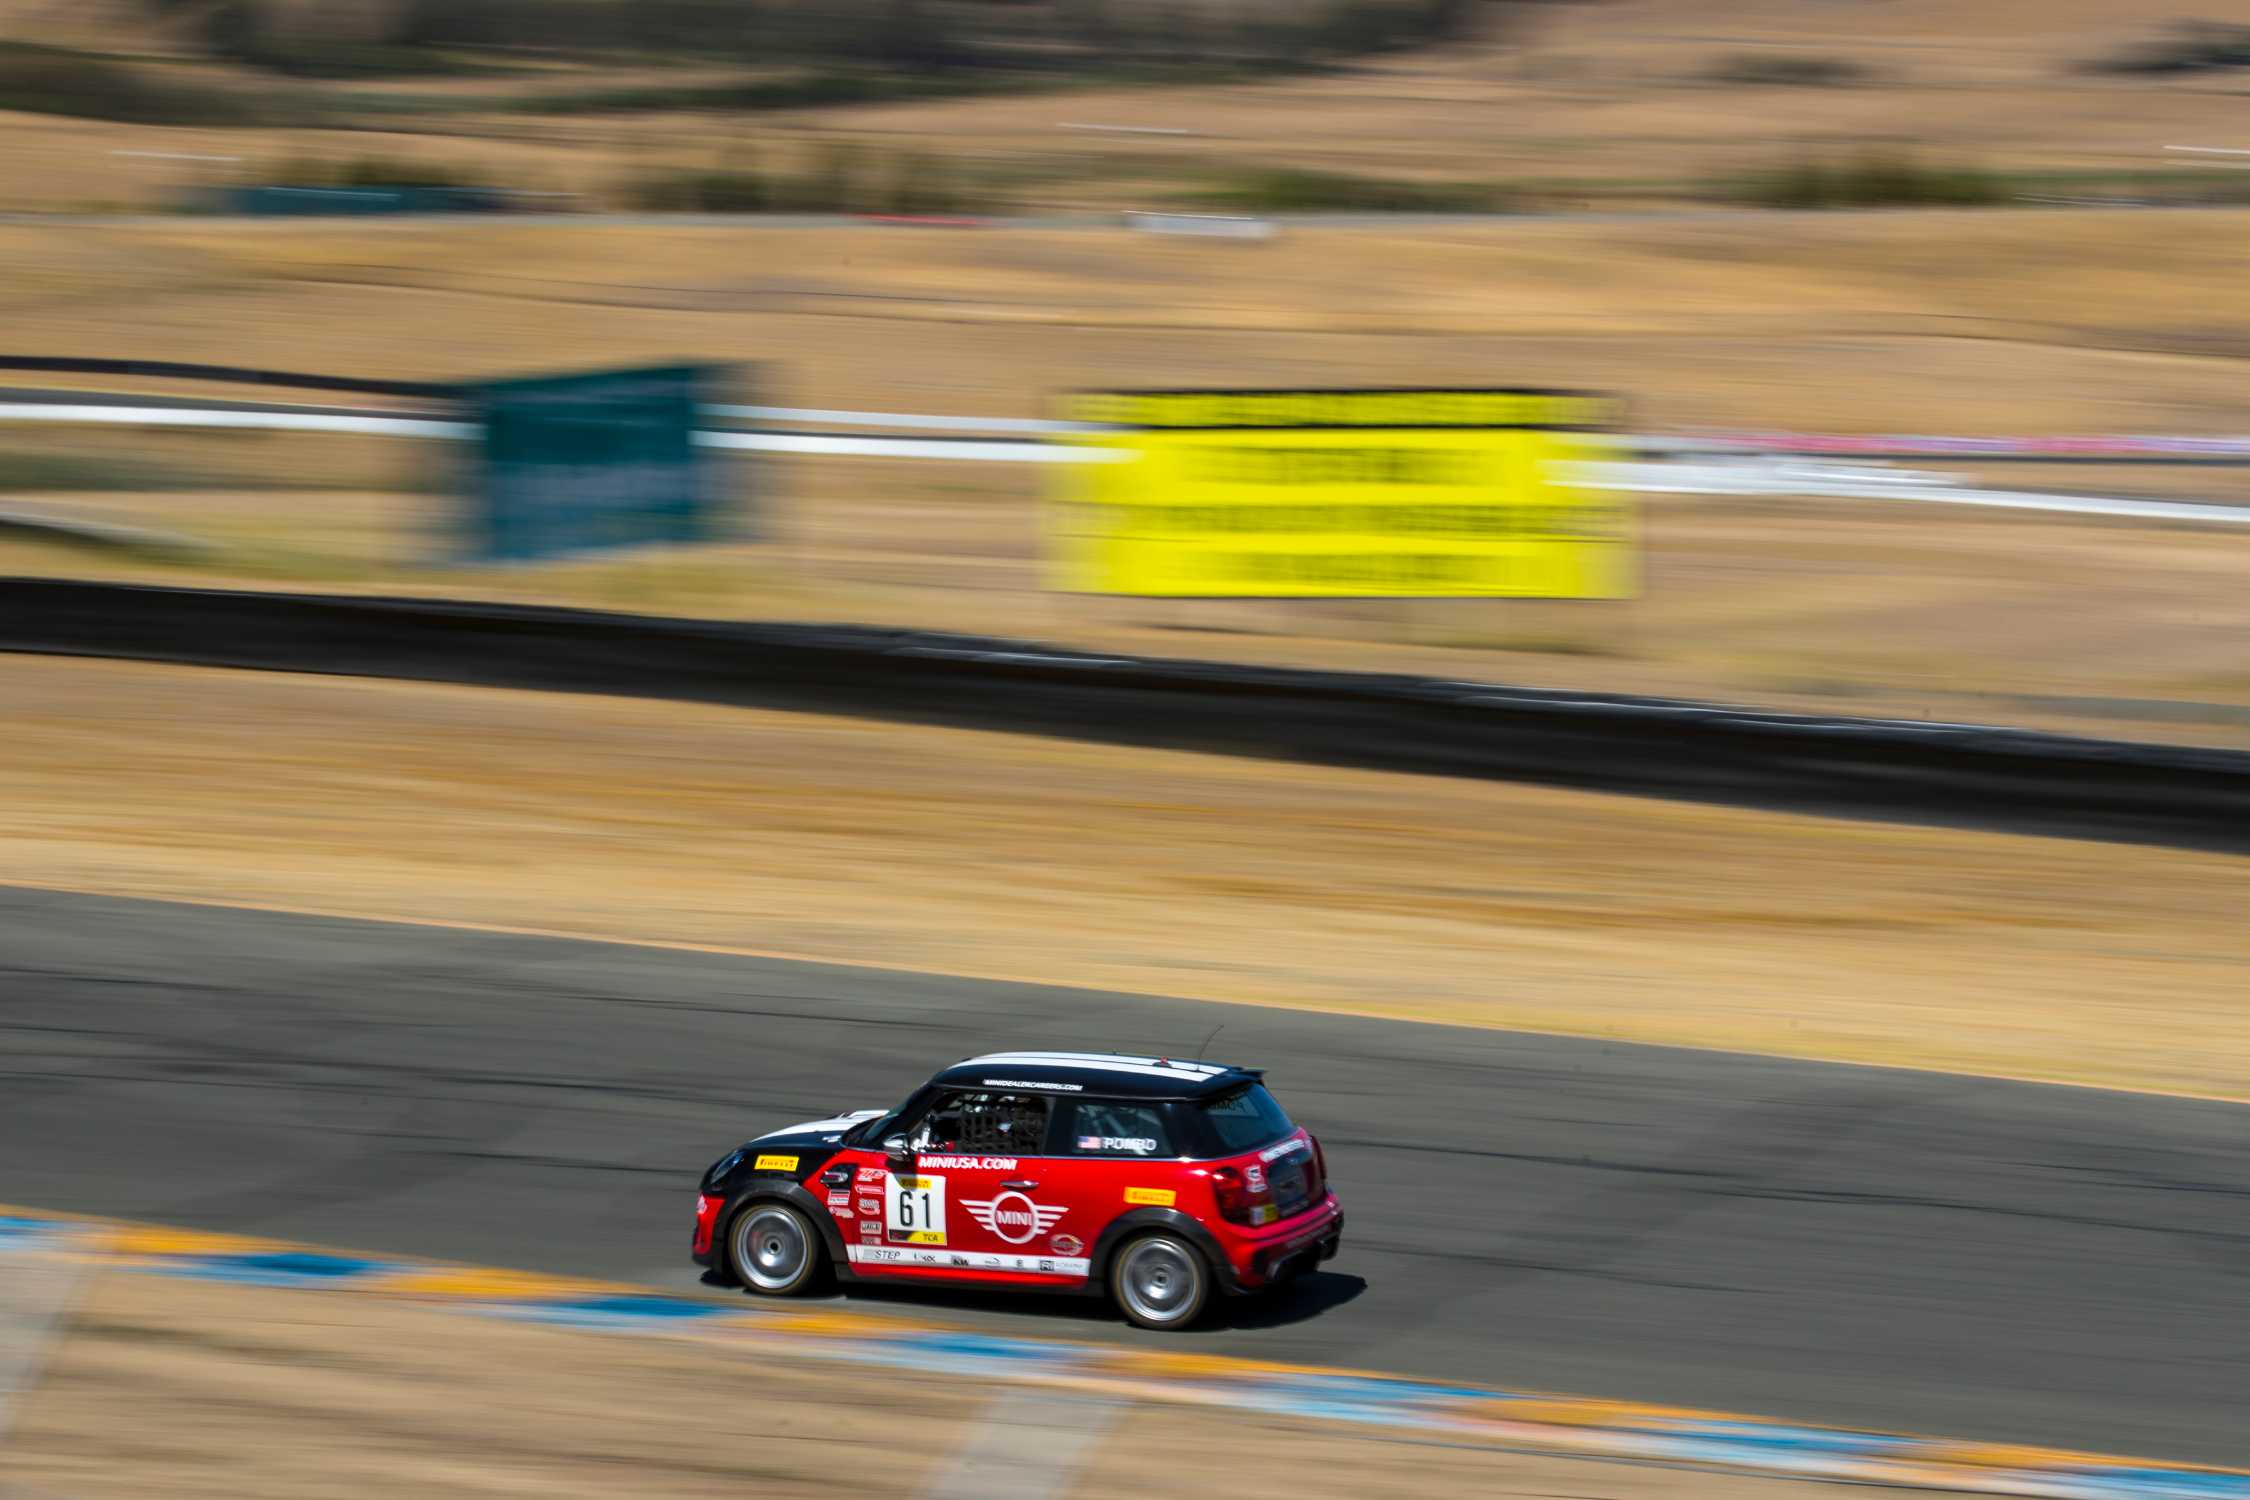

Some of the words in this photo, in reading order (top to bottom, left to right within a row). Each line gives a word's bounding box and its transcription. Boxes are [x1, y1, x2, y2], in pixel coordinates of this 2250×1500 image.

[918, 1155, 1018, 1171] MINIUSA.COM
[899, 1190, 931, 1229] 61
[996, 1210, 1033, 1226] MINI
